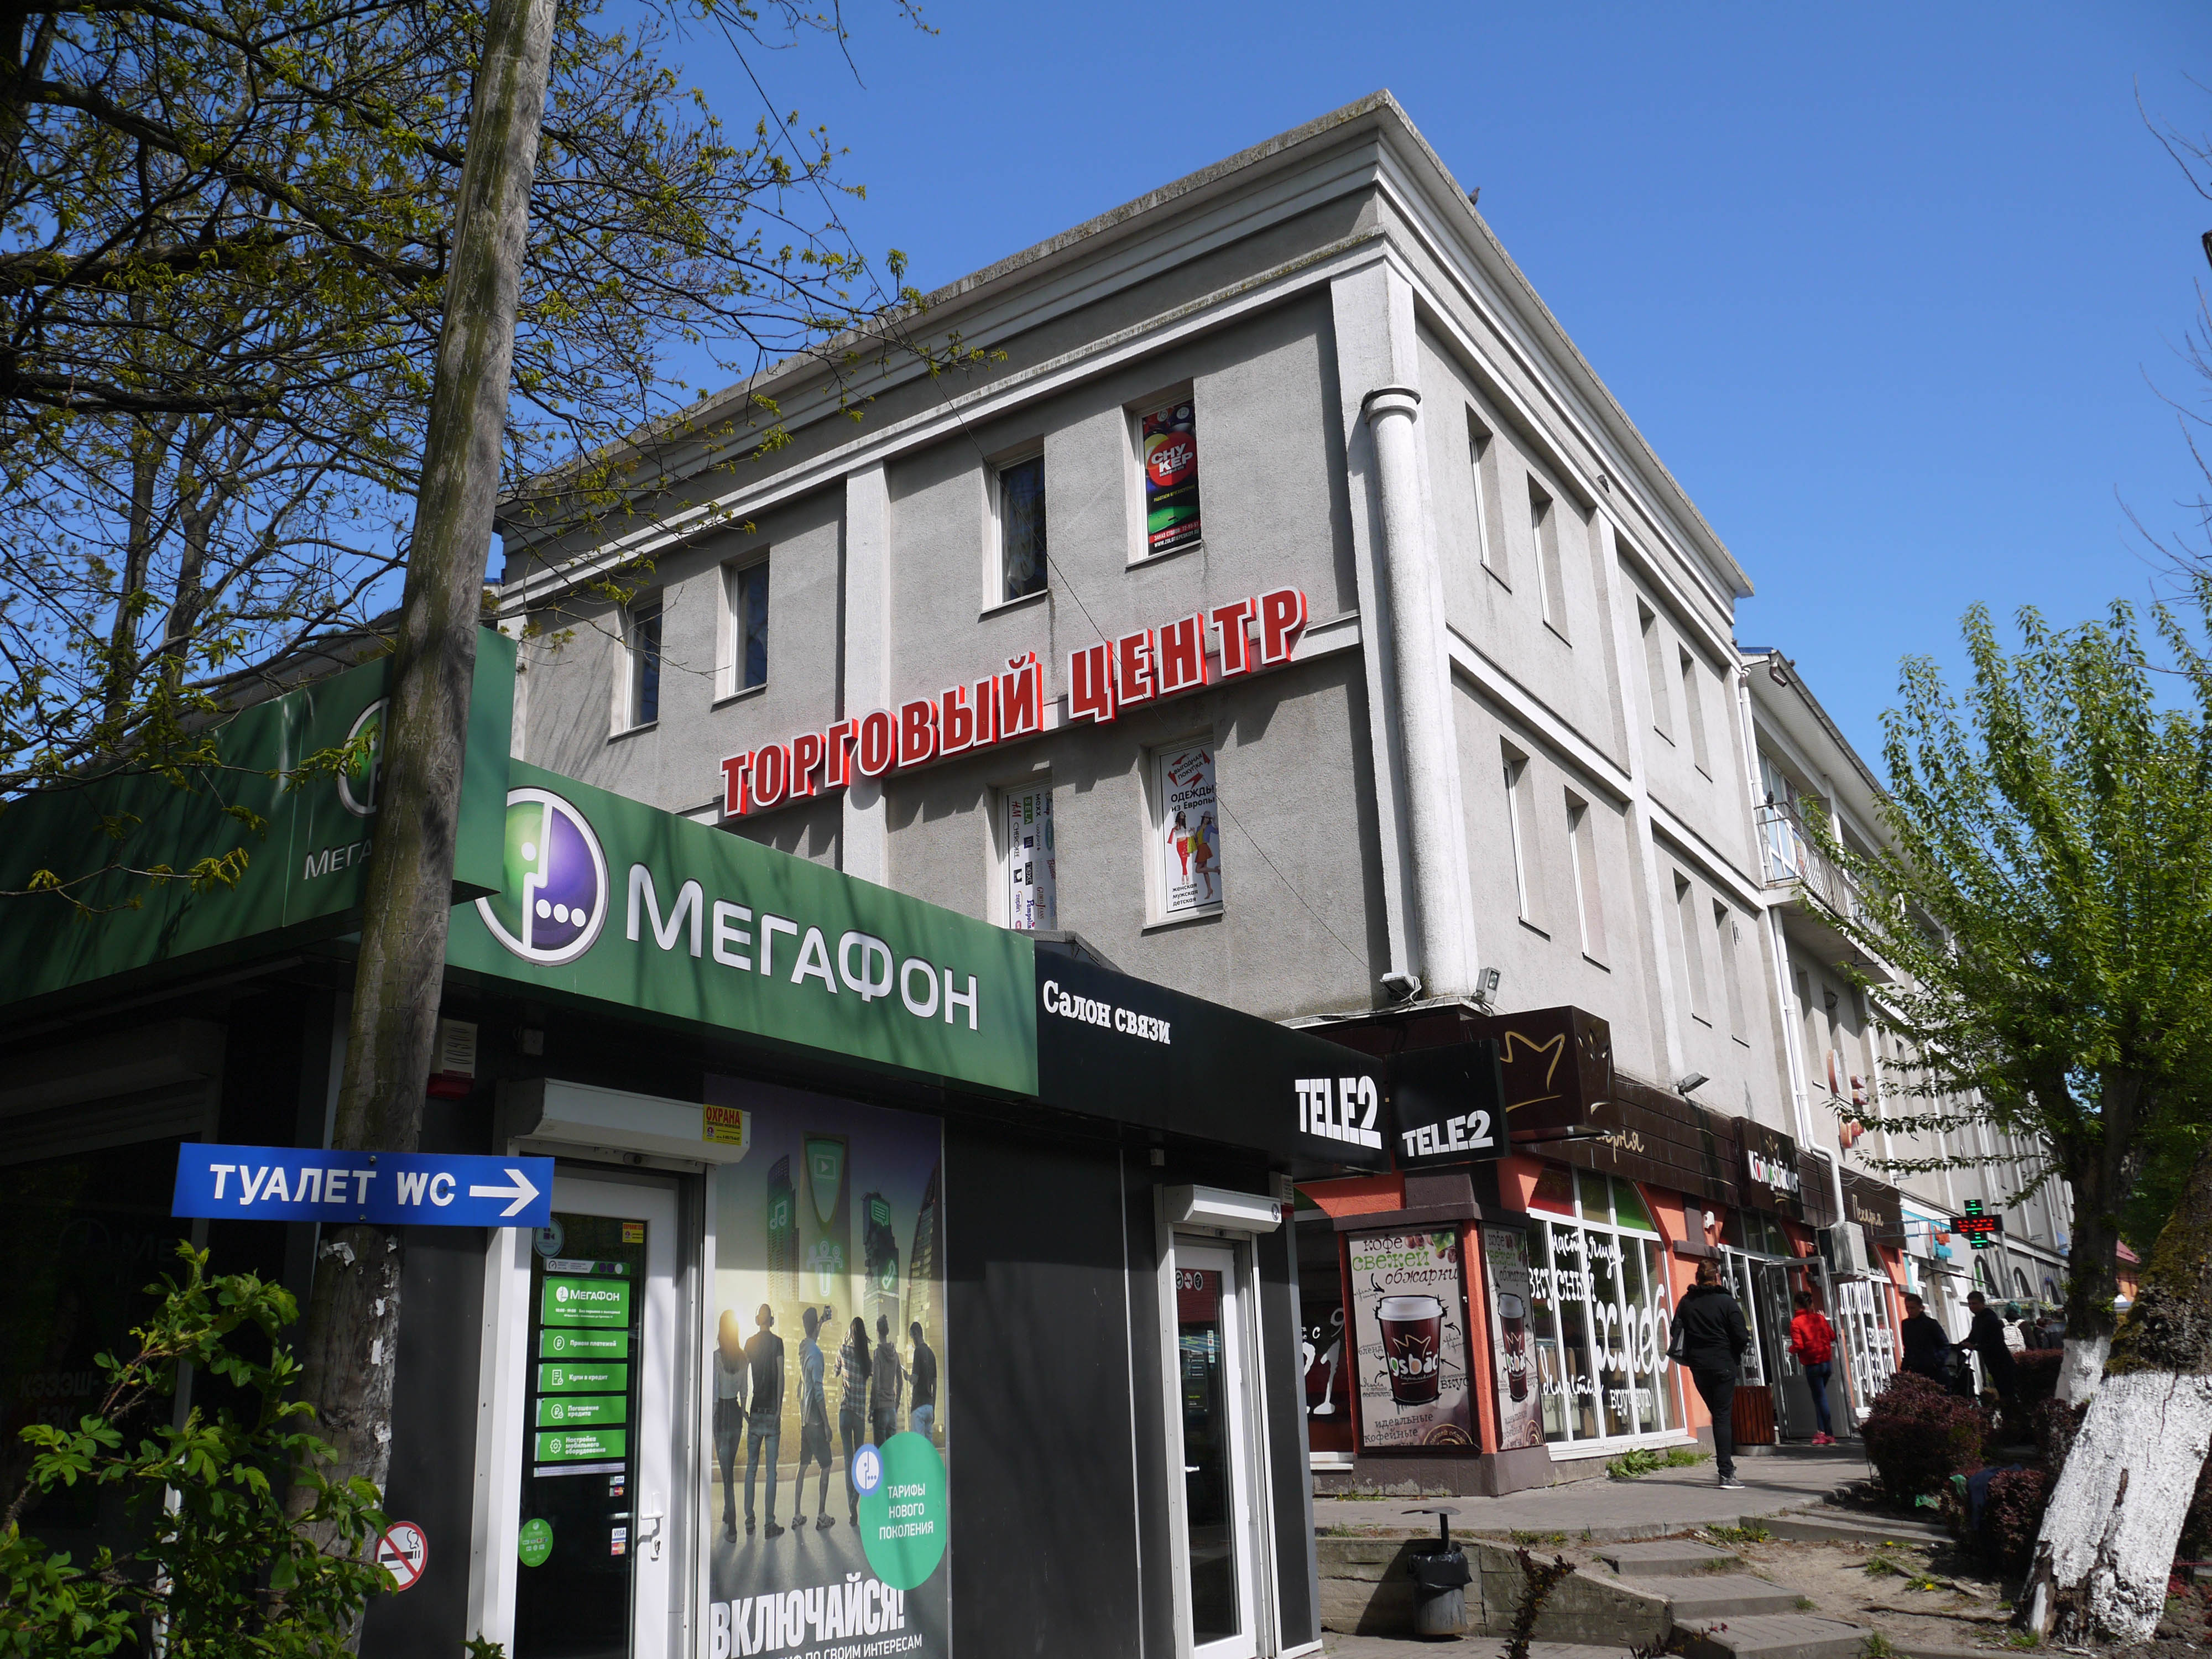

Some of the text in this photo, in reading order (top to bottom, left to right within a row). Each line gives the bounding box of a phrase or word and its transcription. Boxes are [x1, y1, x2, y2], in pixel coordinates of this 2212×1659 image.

[1151, 443, 1186, 465] СНУ
[1159, 452, 1193, 473] КЕР
[719, 585, 1308, 819] ТОРГОВЫЙ ЦЕНТР
[1173, 753, 1203, 775] ВЫГОДНАЯ
[1177, 762, 1203, 781] ПОКУПКА
[1171, 785, 1215, 803] ОДЕЖДЫ
[1171, 796, 1215, 812] из Европы
[303, 838, 373, 881] МЕГА
[1172, 883, 1198, 892] женская
[1172, 890, 1198, 899] мужская
[1172, 897, 1197, 907] детская
[1025, 899, 1035, 930] Pampolin
[1043, 979, 1171, 1045] Салон связи
[706, 1105, 741, 1125] ОХРАНА
[1295, 1075, 1382, 1150] TELE2
[1402, 1109, 1494, 1157] TELE2
[210, 1164, 457, 1207] ТУАЛЕТ WC
[1363, 1234, 1403, 1254] кофе
[1488, 1230, 1505, 1250] кофе
[1352, 1245, 1430, 1271] свежей
[1385, 1267, 1458, 1286] обжарки
[1596, 1284, 1670, 1375] хлеб
[1375, 1413, 1434, 1429] идеальные
[1364, 1427, 1418, 1445] кофейные
[888, 1483, 926, 1499] ТАРИФЫ
[888, 1503, 925, 1519] НОВОГО
[879, 1521, 934, 1541] ПОКОЛЕНИЯ
[709, 1572, 905, 1659] ВКЛЮЧАЙСЯ!
[823, 1644, 861, 1659] СВОИМ
[863, 1633, 922, 1657] ИНТЕРЕСАМ
